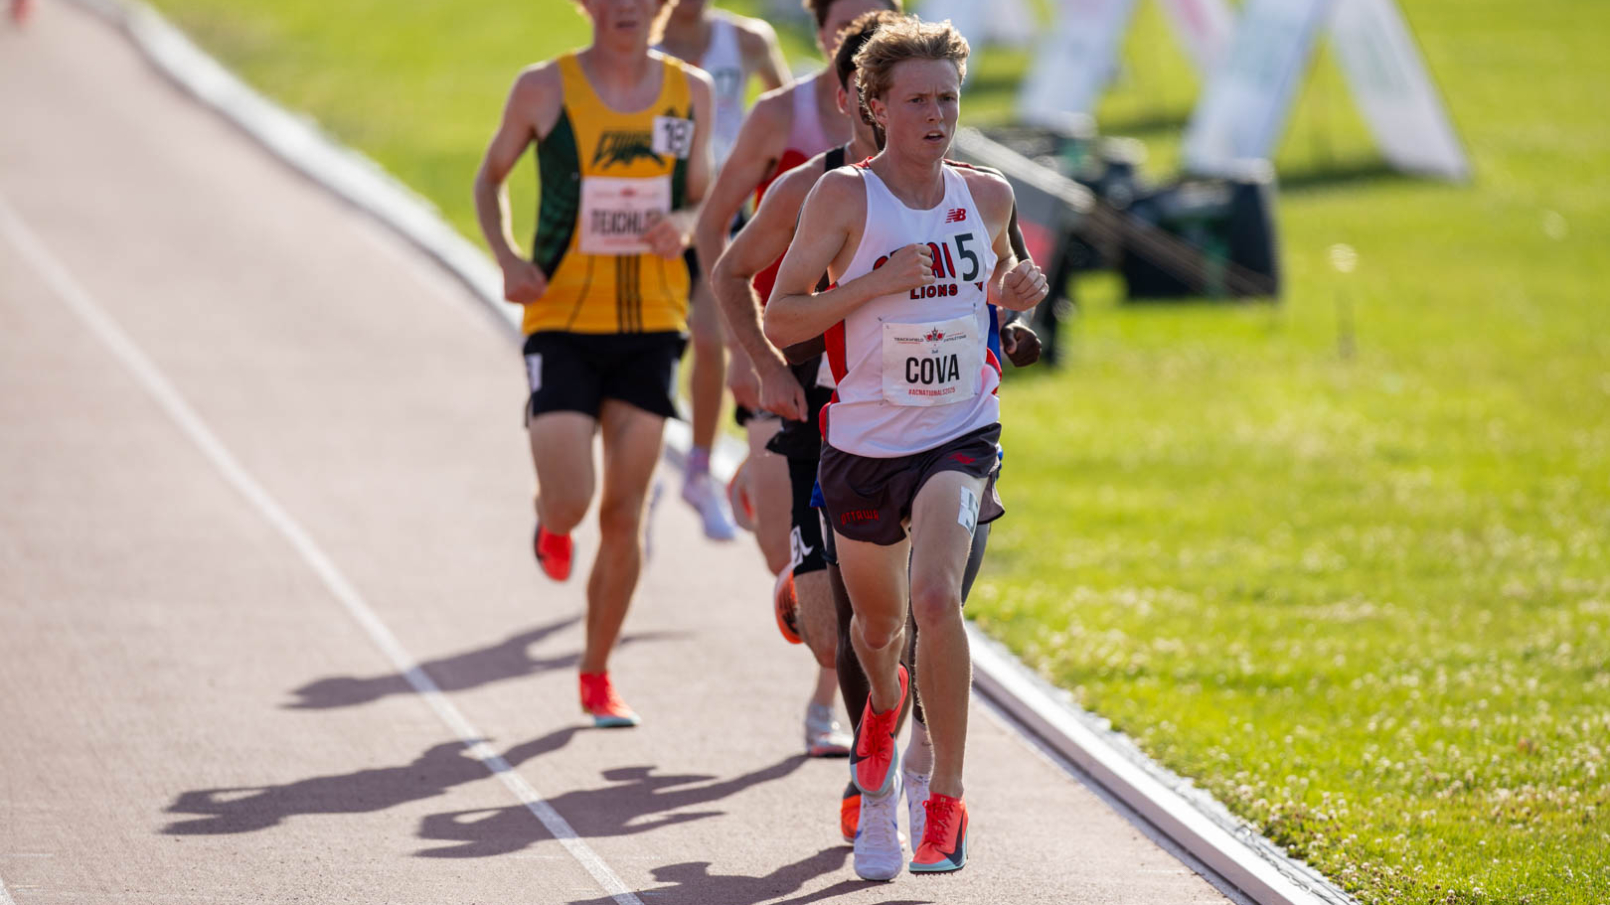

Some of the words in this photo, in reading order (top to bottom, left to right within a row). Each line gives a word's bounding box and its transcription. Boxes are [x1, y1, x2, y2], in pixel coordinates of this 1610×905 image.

[954, 233, 979, 281] 5
[910, 284, 958, 299] LIONS
[905, 353, 960, 385] COVA
